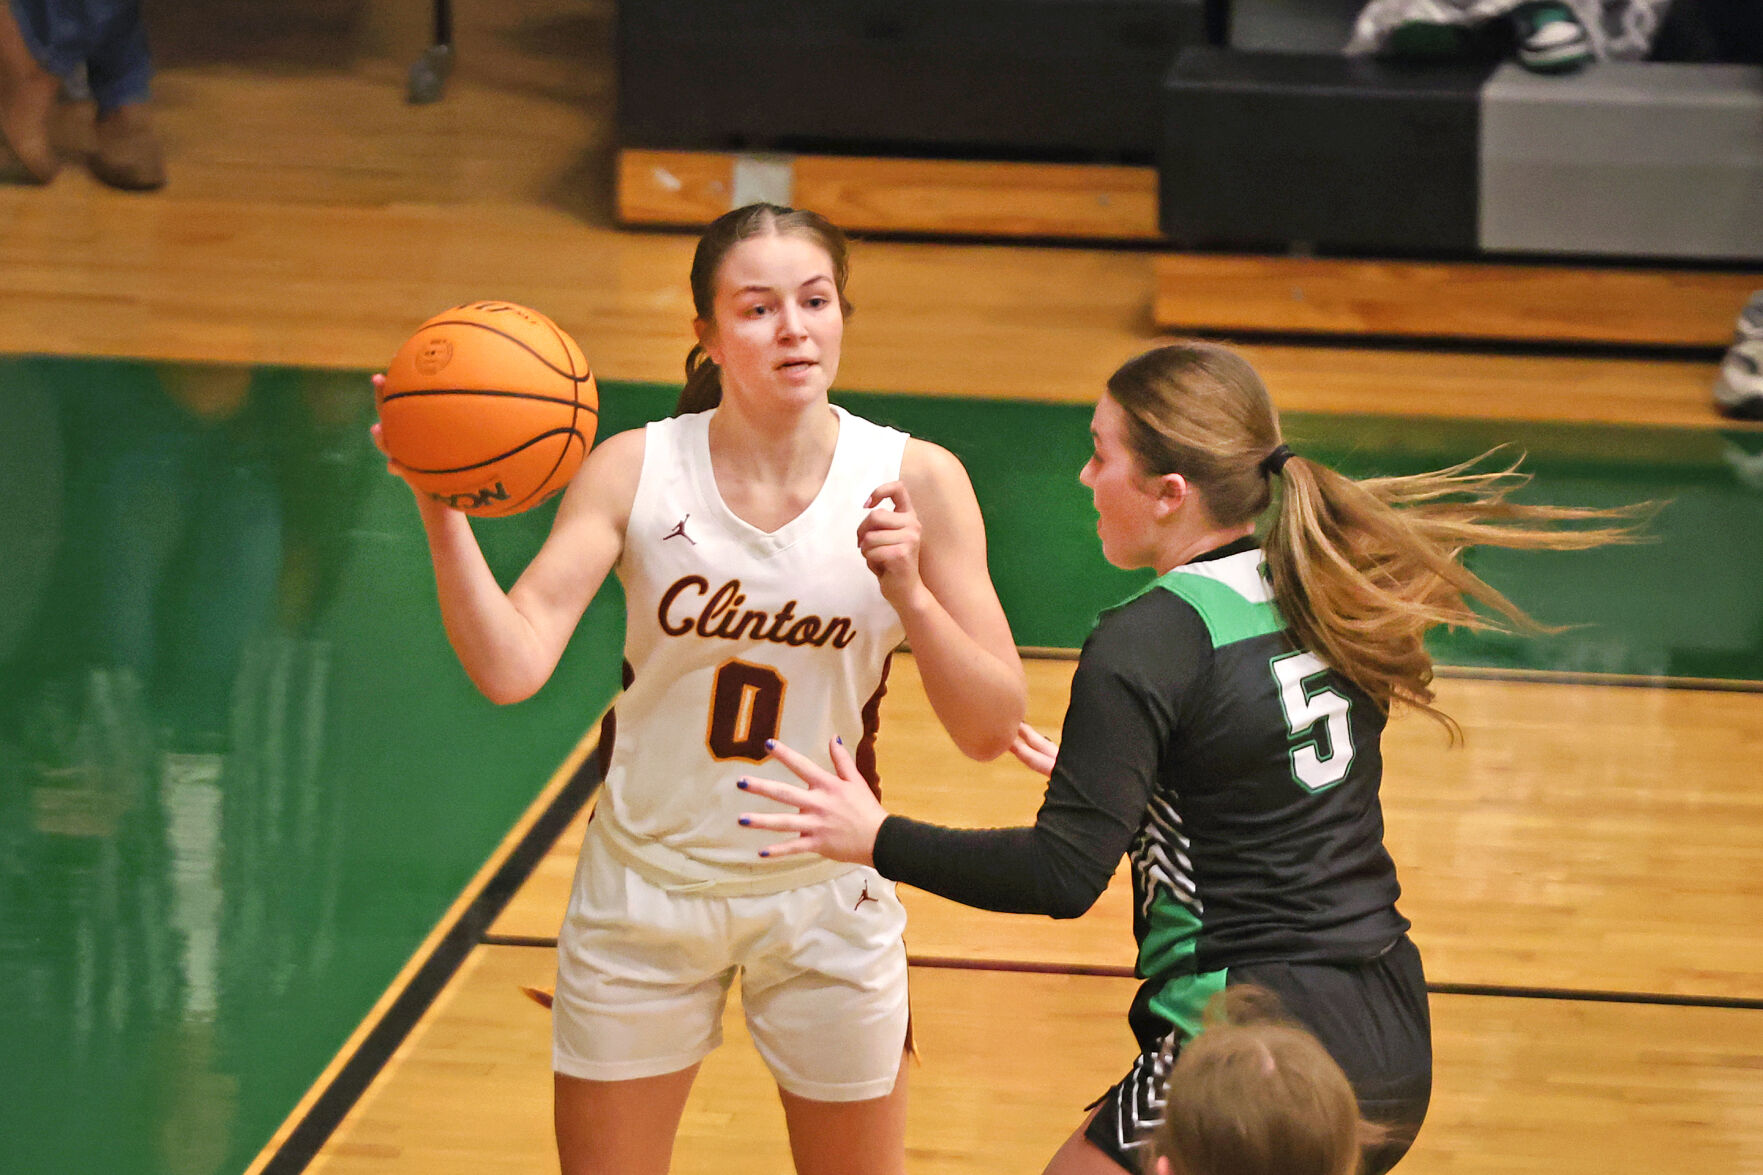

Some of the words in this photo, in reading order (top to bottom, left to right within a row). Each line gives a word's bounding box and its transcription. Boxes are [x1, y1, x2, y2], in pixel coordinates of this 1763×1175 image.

[658, 574, 857, 649] Clinton
[705, 656, 788, 766] 0
[1269, 650, 1356, 794] 5
